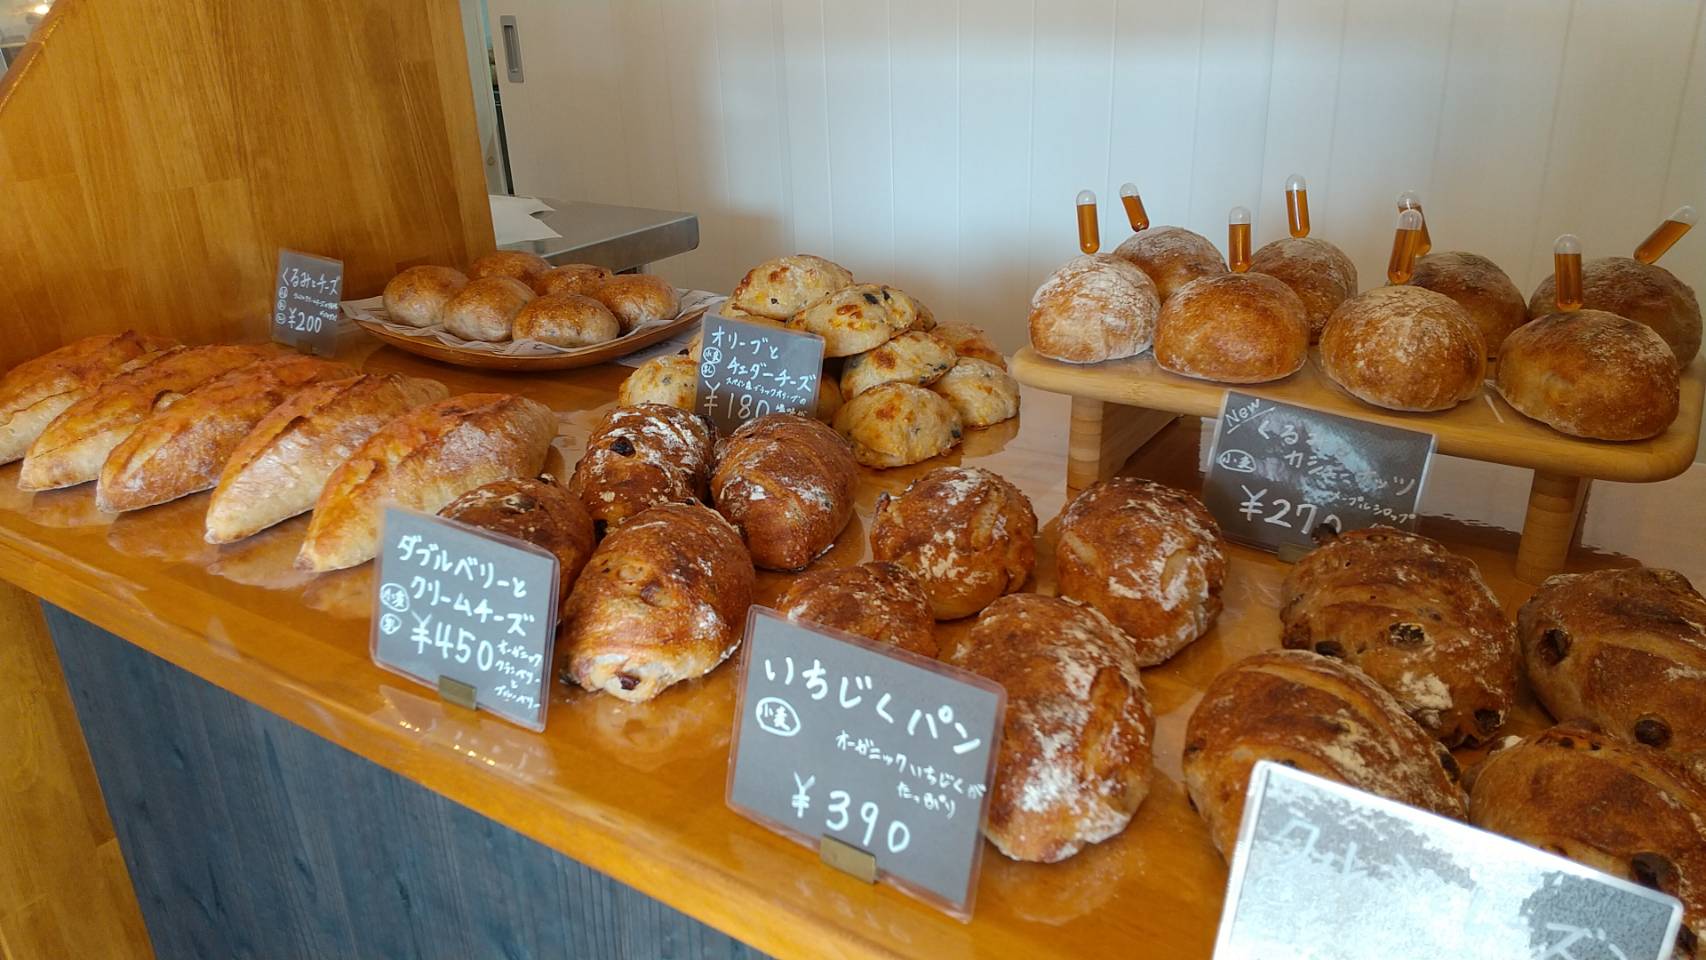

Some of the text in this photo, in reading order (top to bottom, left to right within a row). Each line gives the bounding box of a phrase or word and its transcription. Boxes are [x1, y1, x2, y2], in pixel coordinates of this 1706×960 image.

[287, 307, 322, 333] ¥200
[711, 325, 779, 360] オリーブと
[727, 356, 817, 392] チェダーチーズ
[703, 380, 770, 418] ¥180
[1225, 398, 1261, 428] New
[397, 534, 527, 598] ダブルベリーと
[411, 576, 535, 636] クリームチーズ
[410, 611, 494, 671] ¥450
[759, 699, 797, 733] 小麦
[765, 656, 981, 754] いちじくパン
[791, 771, 910, 853] ¥390
[898, 781, 955, 820] たっぷり
